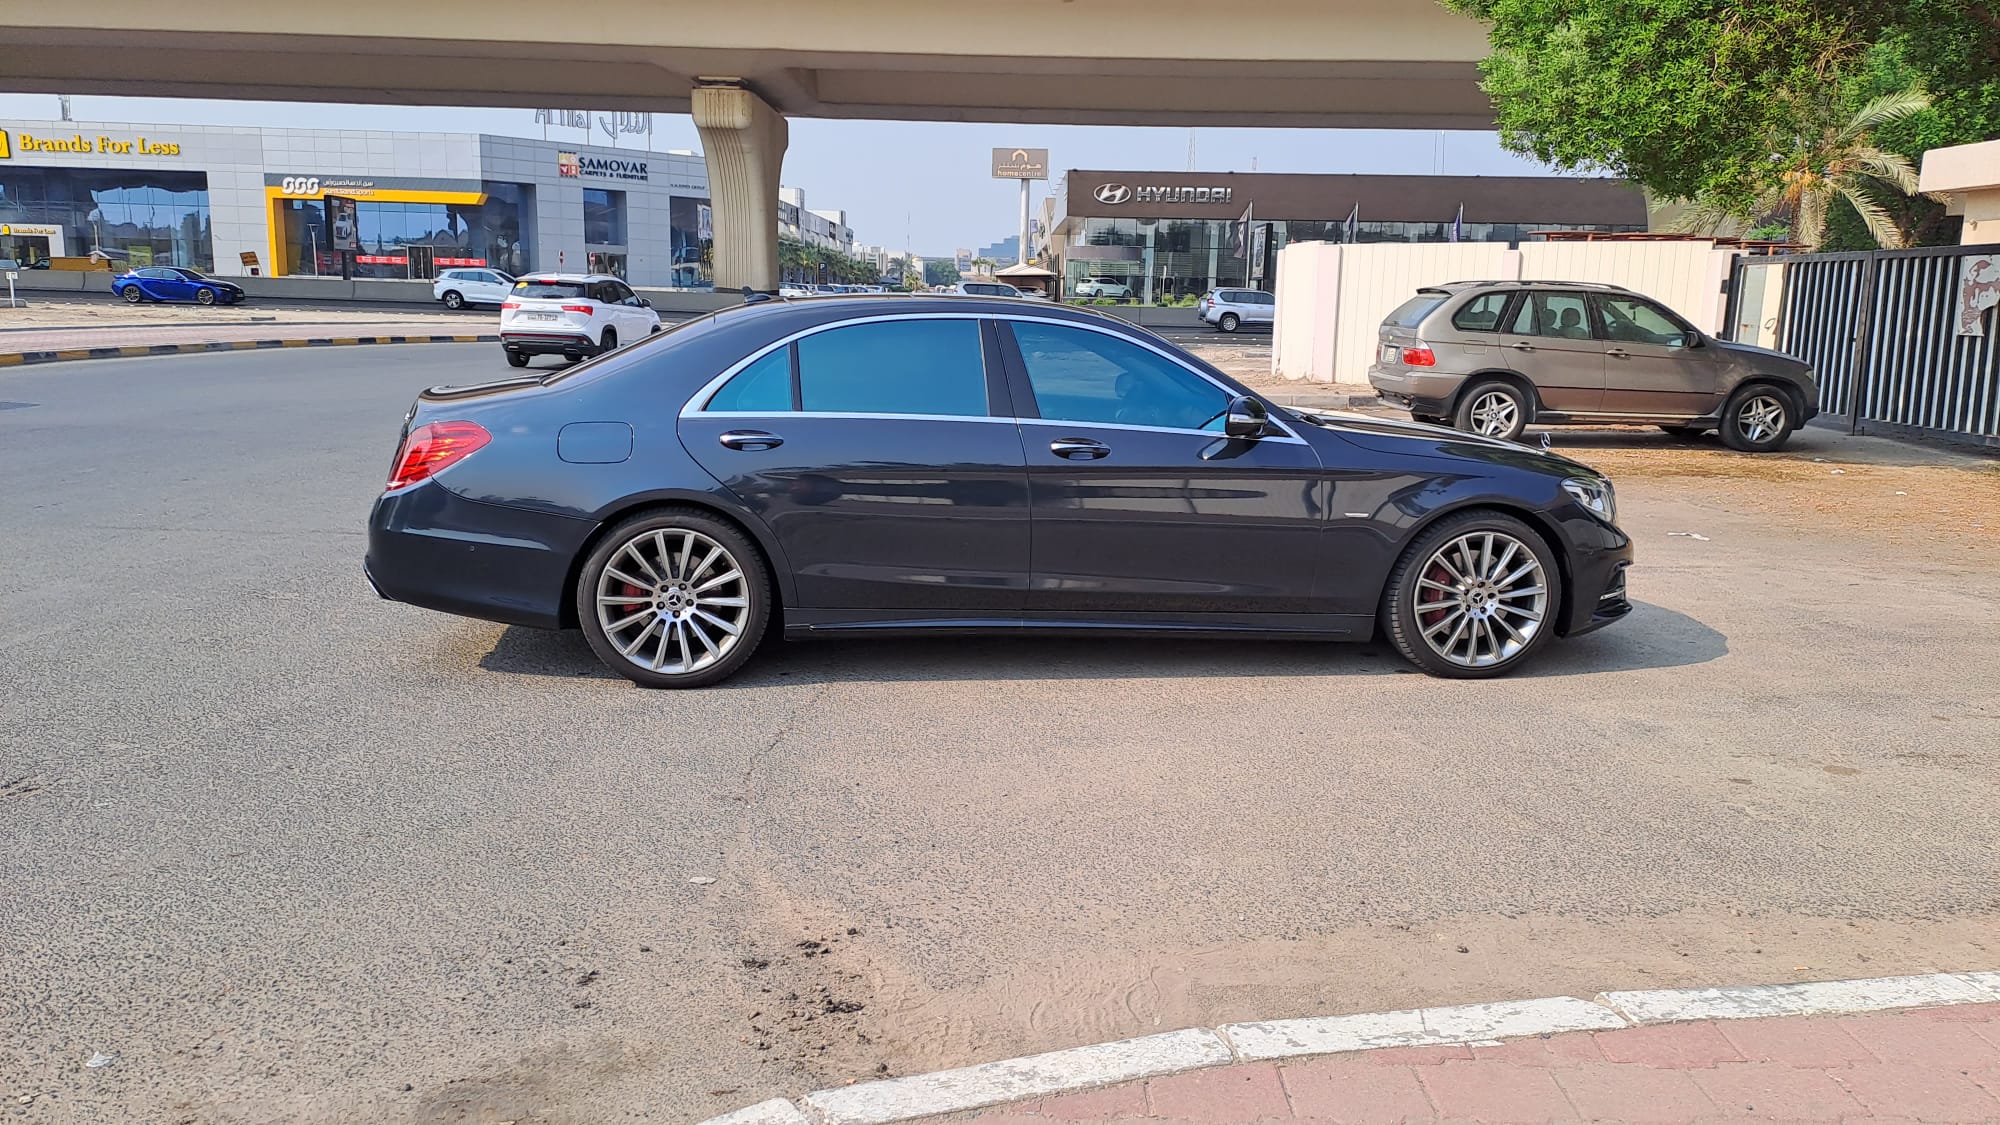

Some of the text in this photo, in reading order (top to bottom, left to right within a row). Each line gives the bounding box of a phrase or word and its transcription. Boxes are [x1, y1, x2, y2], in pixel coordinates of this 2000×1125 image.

[18, 133, 92, 153] Brands
[96, 135, 132, 154] For
[137, 136, 181, 155] Less
[579, 157, 648, 174] SAMOVAR
[579, 169, 607, 177] CARPETS
[616, 173, 648, 181] FURNITURE
[1137, 186, 1232, 203] HYUNDAI
